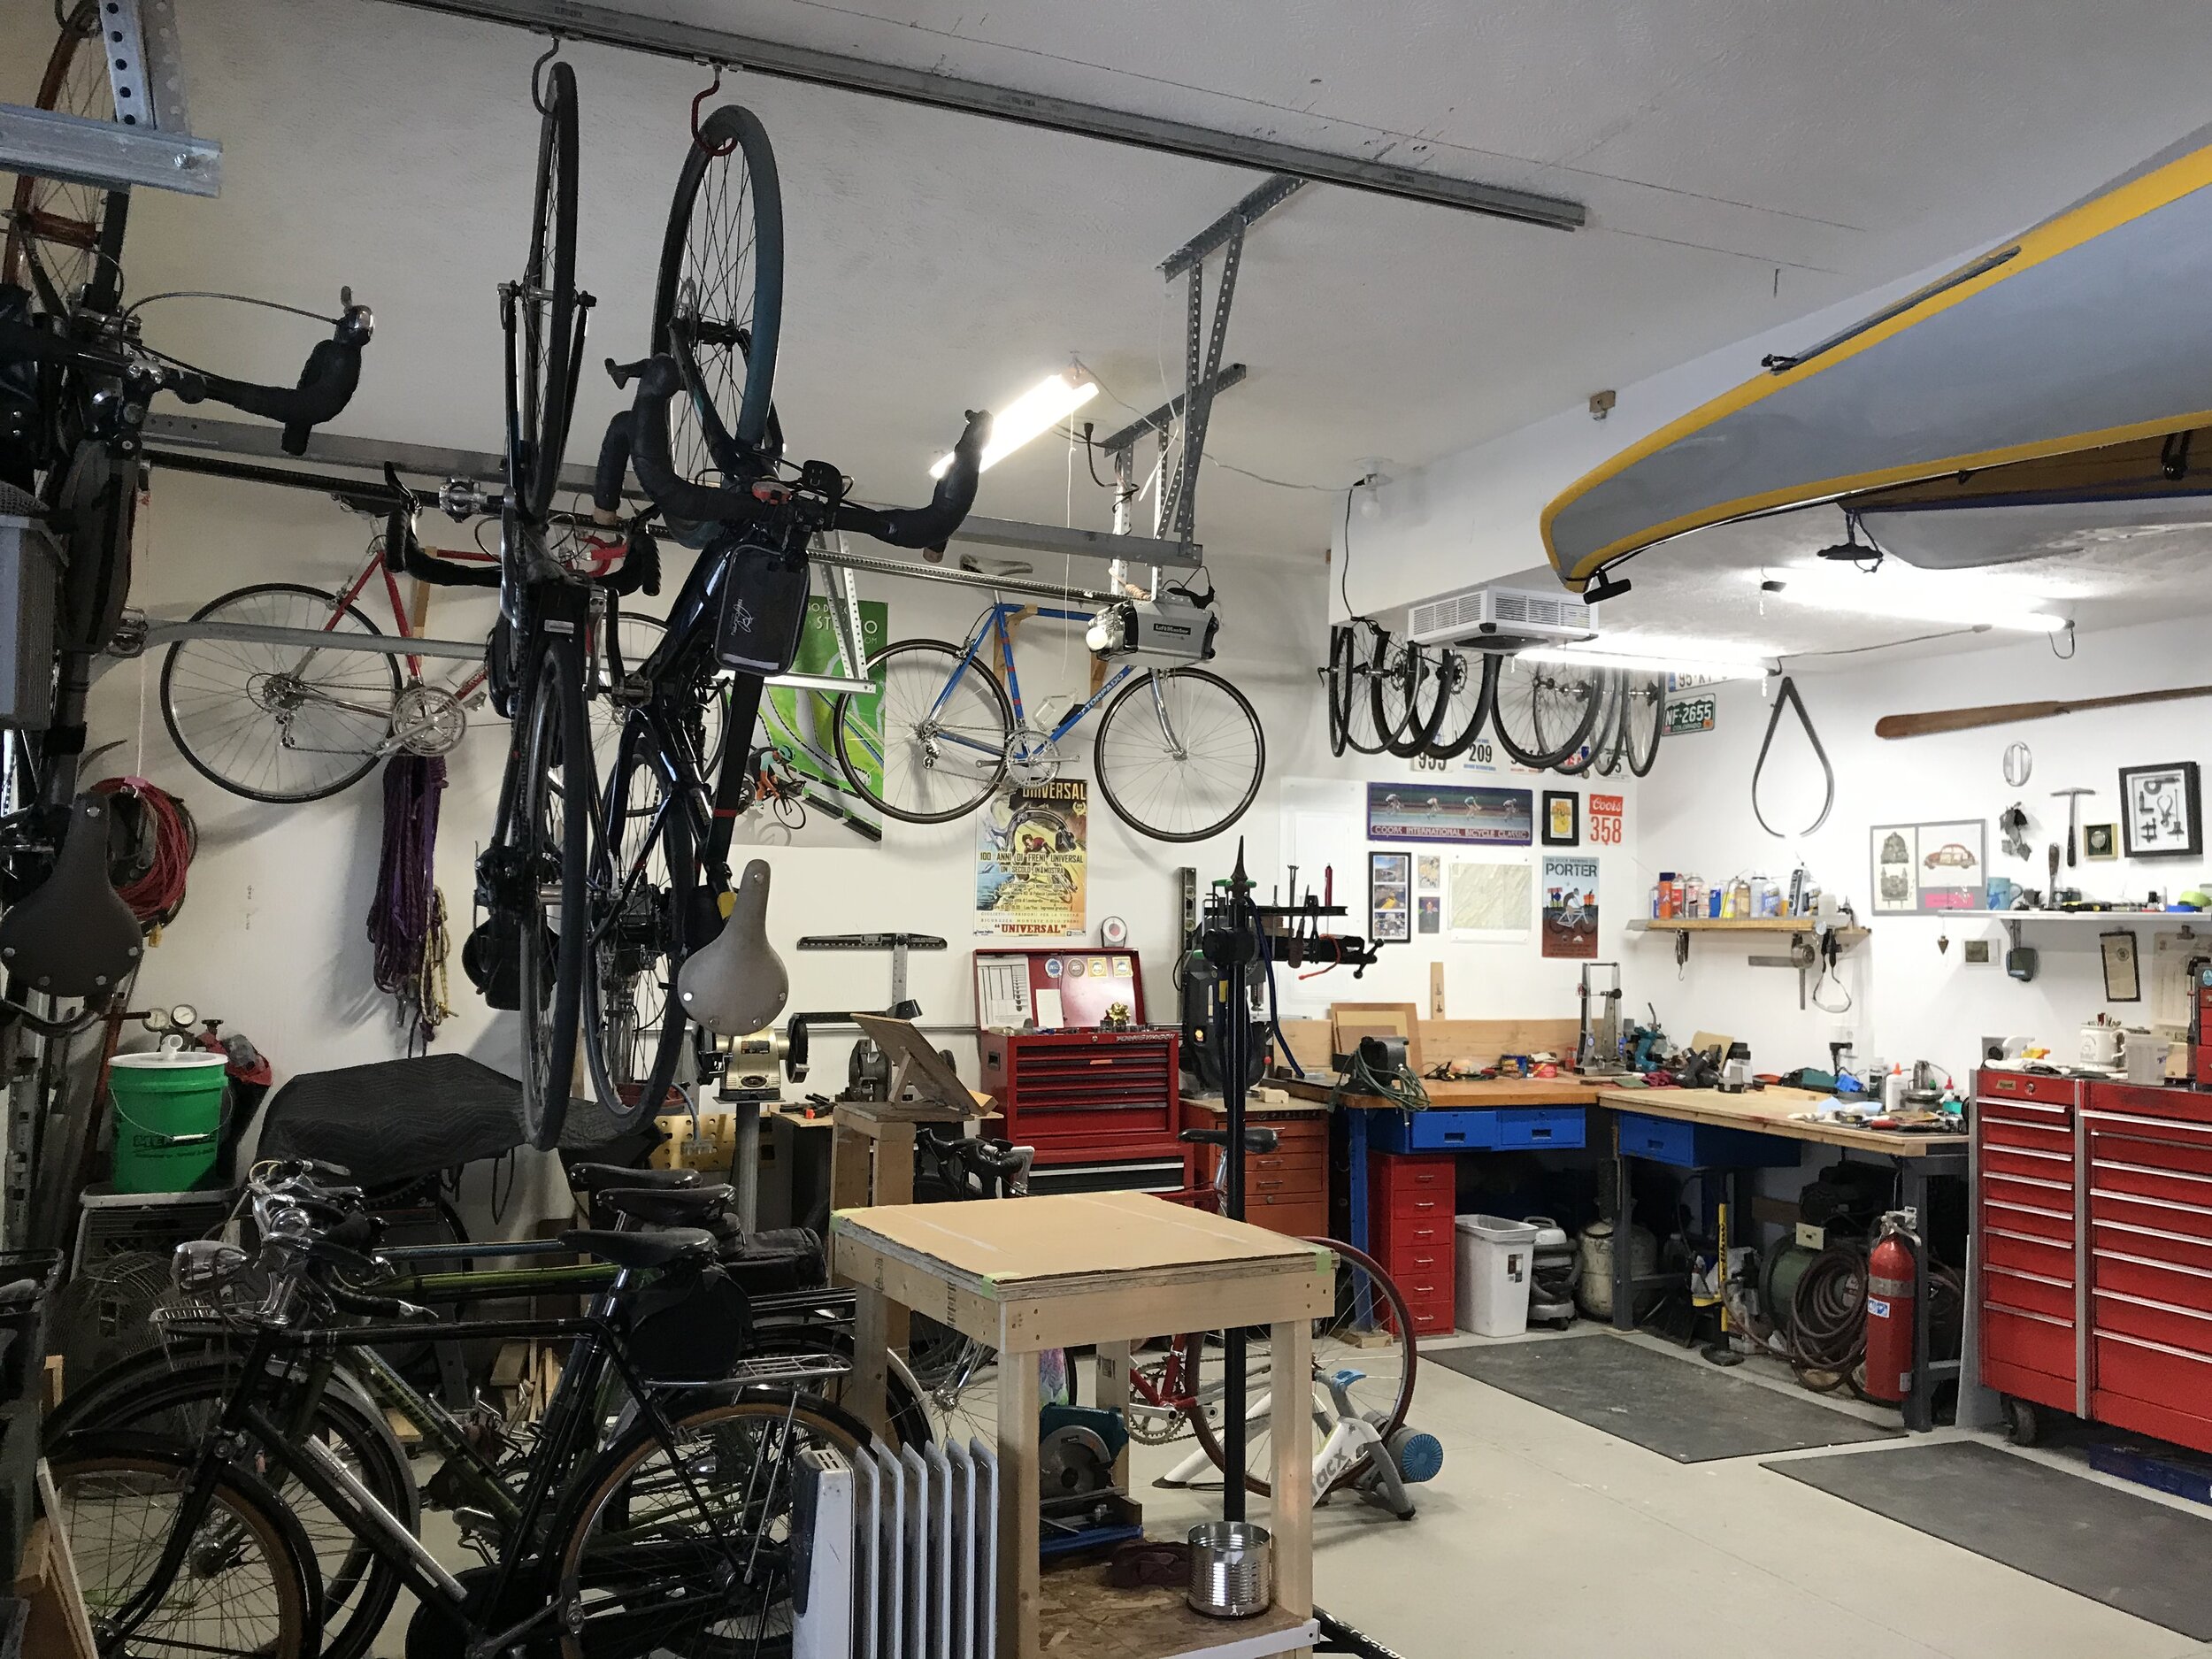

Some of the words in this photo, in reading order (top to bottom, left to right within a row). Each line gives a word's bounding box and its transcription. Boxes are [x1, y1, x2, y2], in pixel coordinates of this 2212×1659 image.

[1156, 625, 1189, 634] LiftMaster
[1079, 673, 1124, 715] TORPADO
[1470, 743, 1493, 763] 209
[1593, 797, 1622, 812] Coors
[1406, 827, 1461, 836] INTERNATIONAL
[1465, 828, 1494, 837] BICYCLE
[1590, 816, 1622, 844] 358
[1050, 854, 1083, 863] UNIVERSAL
[1546, 863, 1598, 878] PORTER
